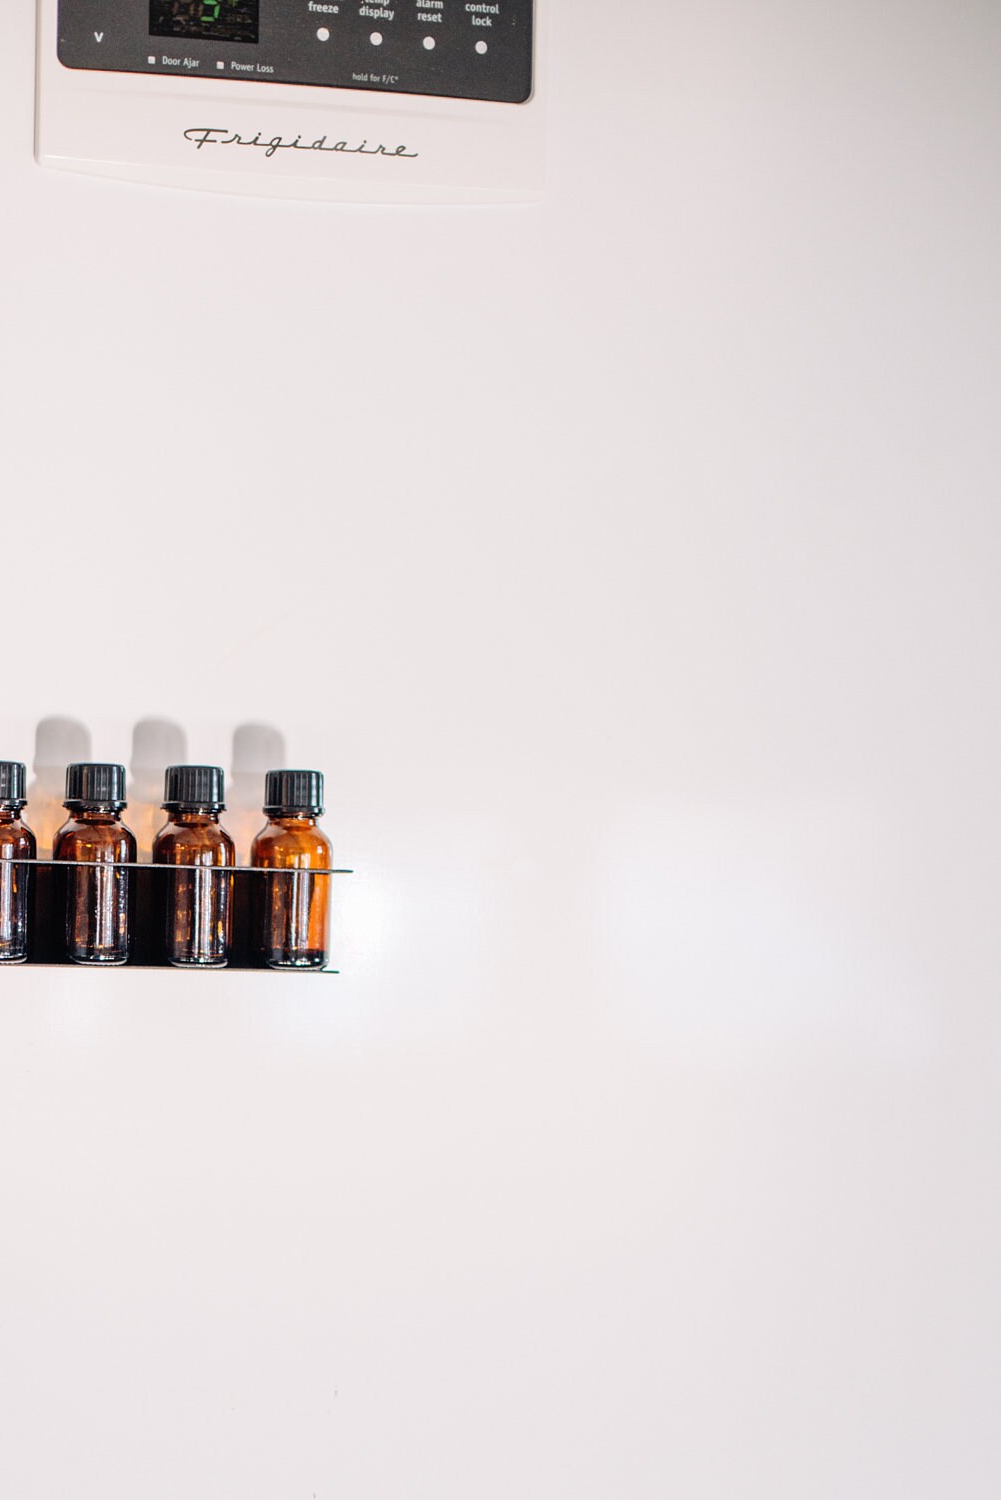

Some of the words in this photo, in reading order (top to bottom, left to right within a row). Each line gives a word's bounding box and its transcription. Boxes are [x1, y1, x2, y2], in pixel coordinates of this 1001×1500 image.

[308, 1, 339, 13] freeze
[359, 6, 395, 20] display
[465, 3, 499, 14] control
[417, 12, 442, 23] reset
[471, 15, 492, 26] lock
[162, 56, 181, 66] Door
[182, 58, 200, 69] Ajar
[230, 61, 255, 72] Power
[256, 63, 275, 73] Loss
[352, 72, 369, 82] hold
[369, 73, 381, 82] for
[183, 127, 419, 158] Frigidaire
